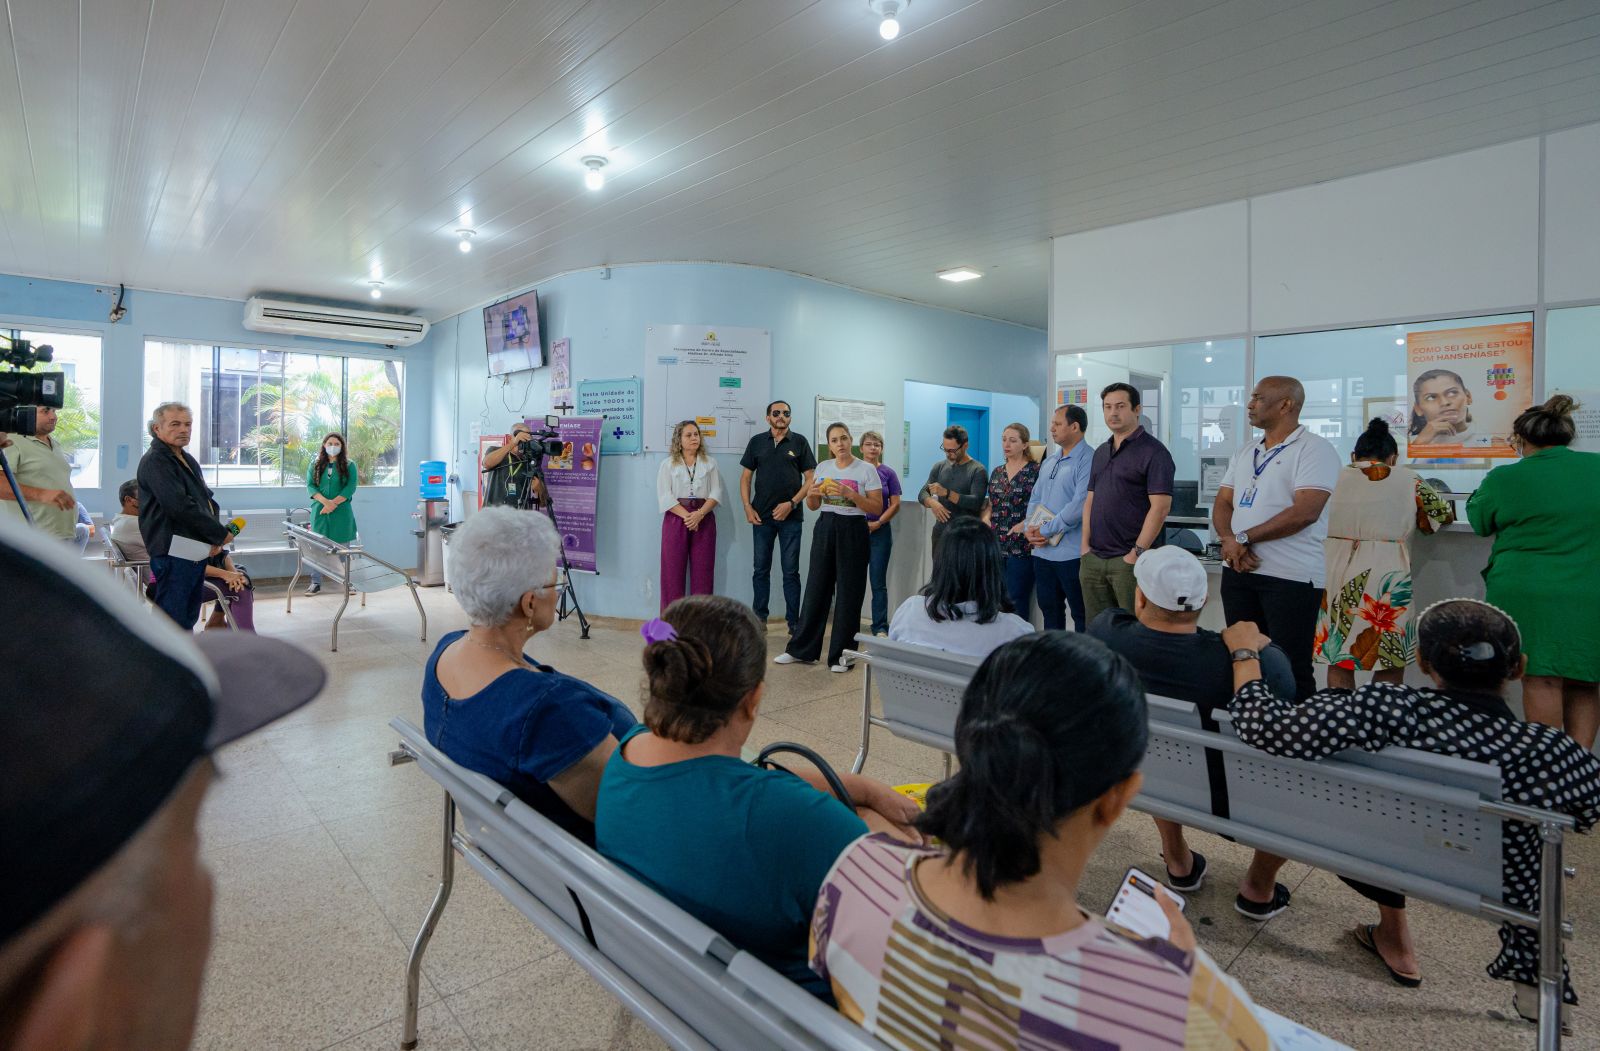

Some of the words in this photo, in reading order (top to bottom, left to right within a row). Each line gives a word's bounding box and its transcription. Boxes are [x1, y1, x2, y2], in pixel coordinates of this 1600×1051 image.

[1412, 346, 1442, 355] COMO
[1444, 344, 1460, 352] SEI
[1462, 342, 1485, 351] QUE
[1487, 339, 1523, 348] ESTOU
[1412, 355, 1434, 363] COM
[1437, 349, 1506, 361] HANSENÍASE?
